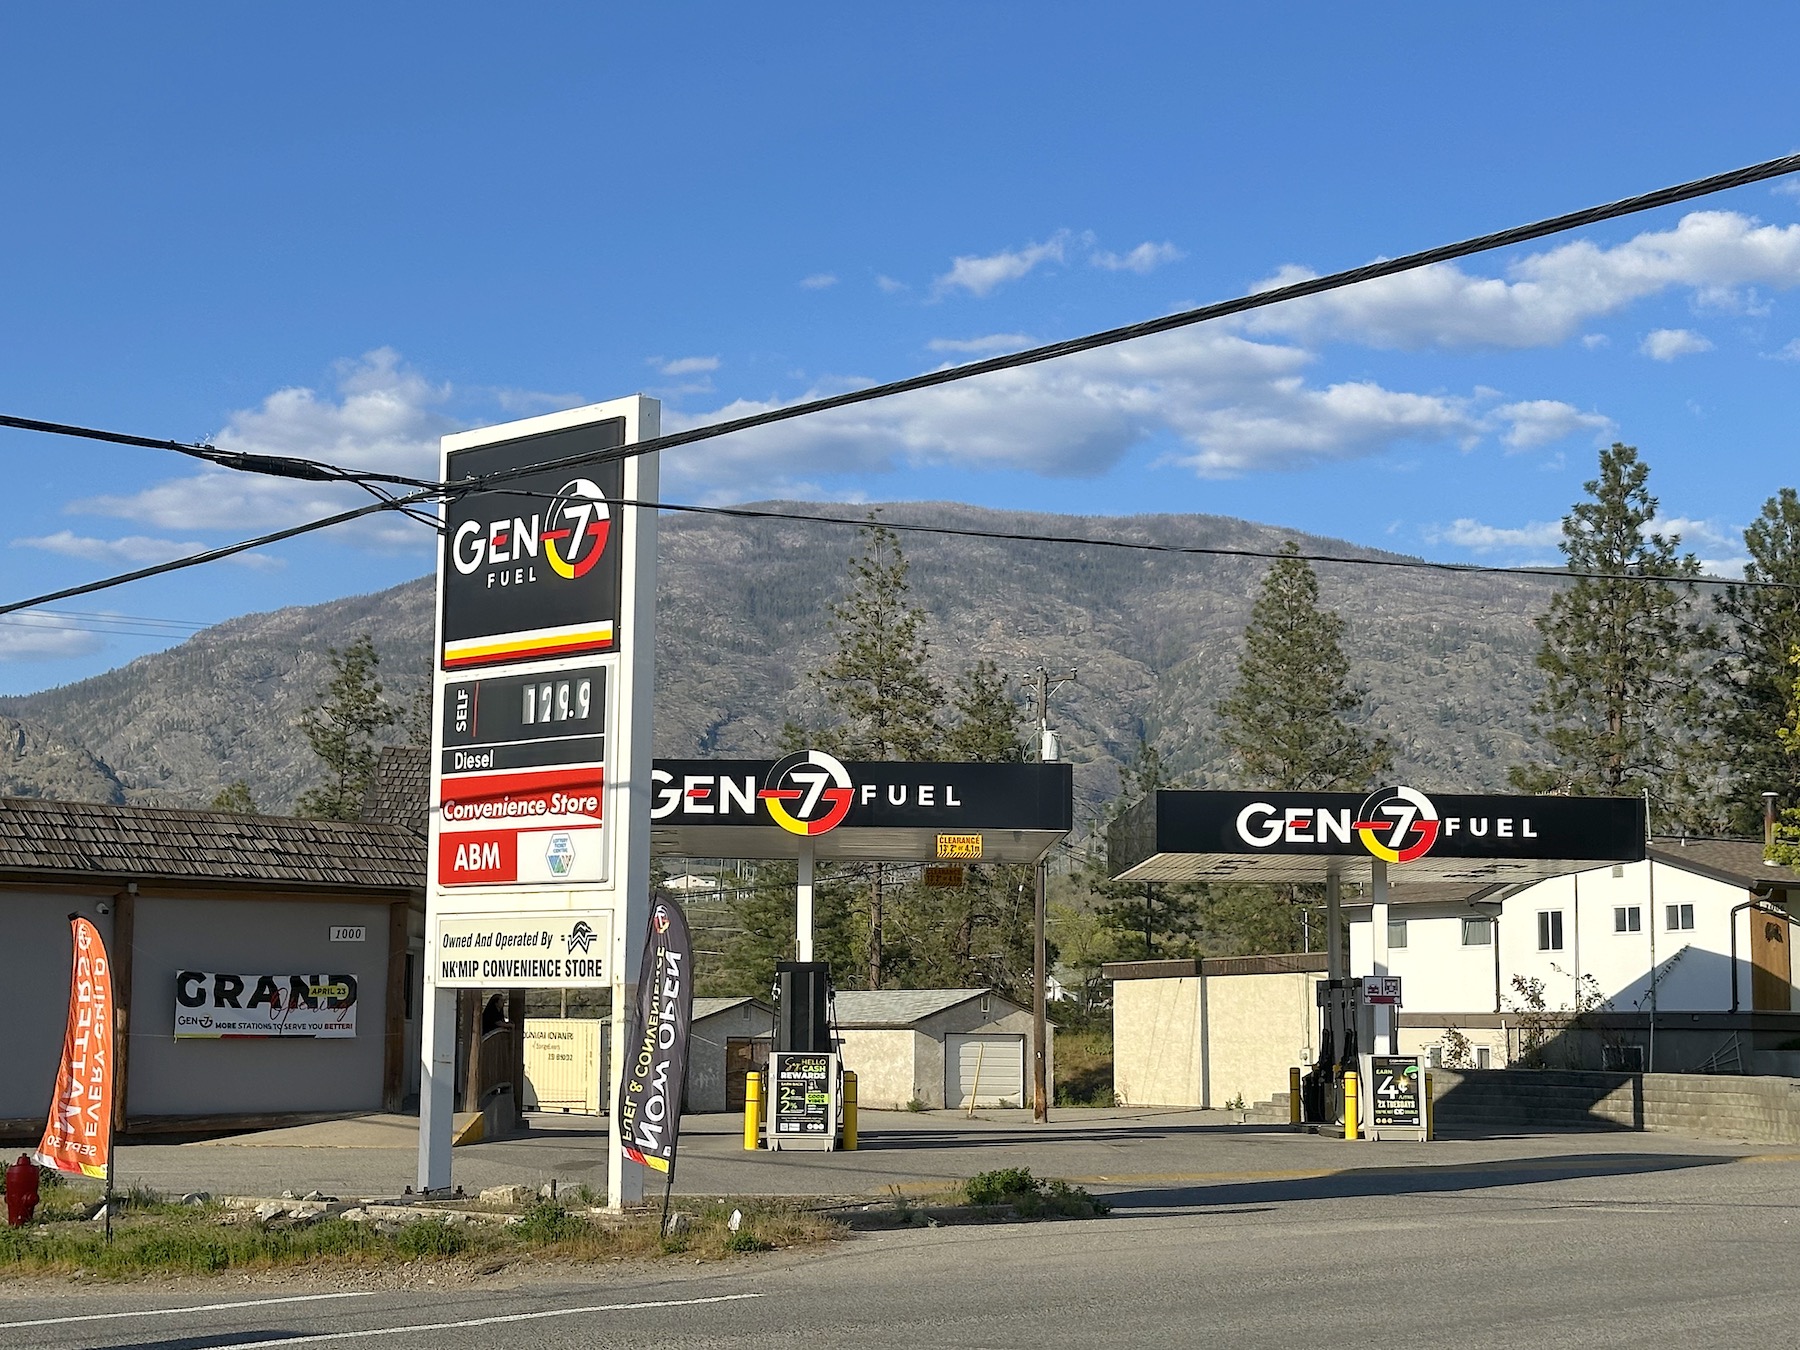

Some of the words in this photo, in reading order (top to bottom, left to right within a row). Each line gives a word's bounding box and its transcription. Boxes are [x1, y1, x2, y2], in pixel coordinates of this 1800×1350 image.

[453, 513, 540, 575] GEN
[486, 566, 537, 588] FUEL
[456, 688, 469, 733] SELF
[525, 680, 591, 724] 129.9
[454, 749, 494, 770] Diesel
[443, 795, 547, 822] Convenience
[548, 792, 599, 814] Store
[861, 784, 962, 807] FUEL
[1236, 801, 1351, 848] GEN
[1445, 816, 1538, 838] FUEL
[453, 842, 502, 872] ABM
[335, 928, 361, 939] 1000
[443, 931, 474, 949] Owned
[475, 929, 494, 947] And
[495, 927, 538, 951] Operated
[540, 930, 553, 949] By
[483, 959, 562, 978] CONVENIENCE
[565, 958, 602, 977] STORE
[177, 971, 357, 1009] GRAND
[336, 987, 346, 995] 23
[178, 1015, 198, 1025] GEN
[780, 1071, 826, 1079] REWARDS
